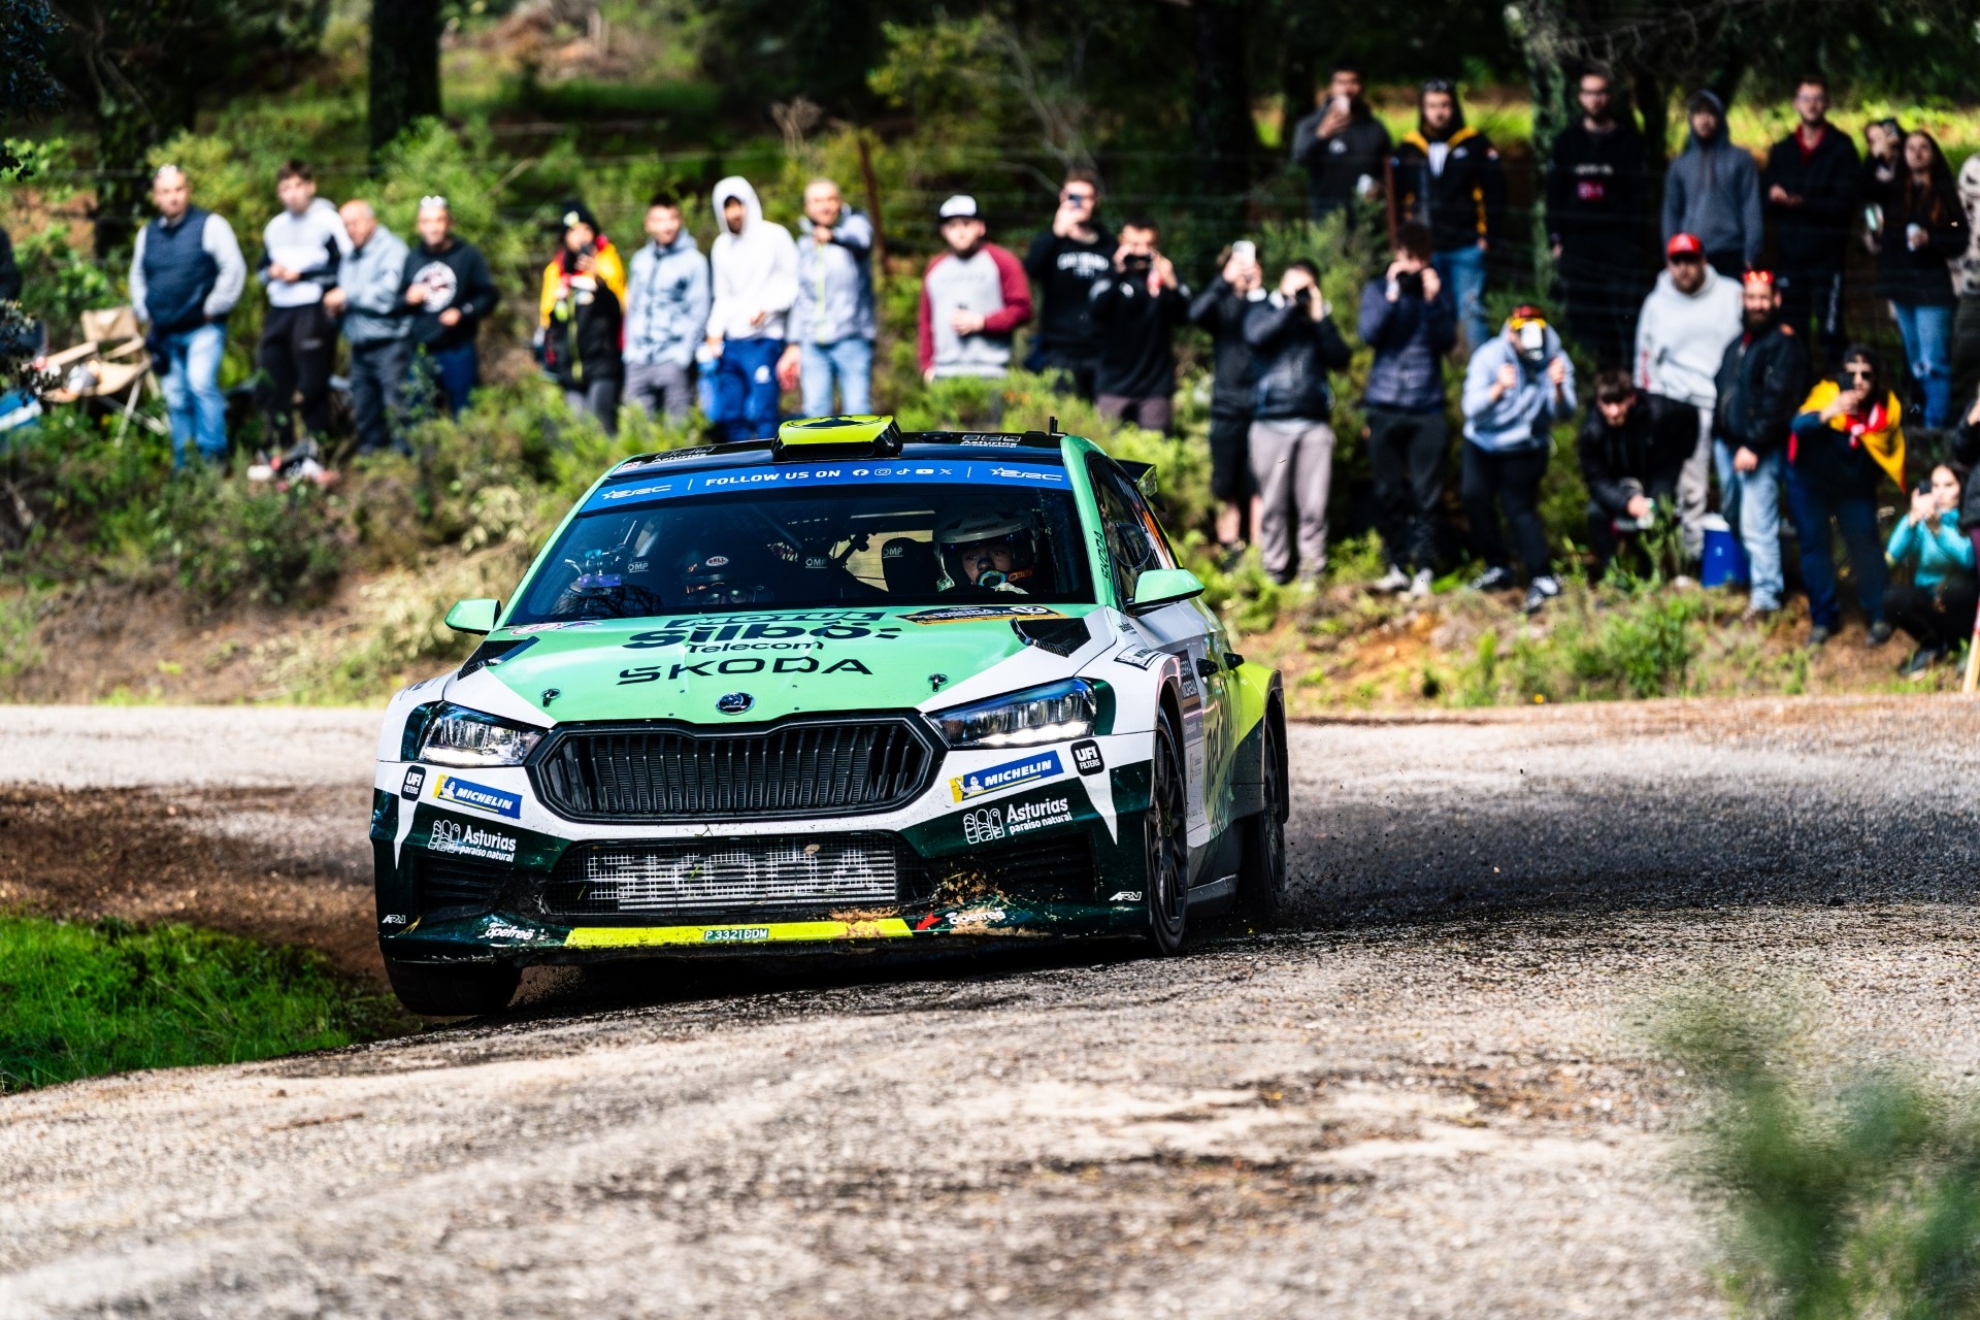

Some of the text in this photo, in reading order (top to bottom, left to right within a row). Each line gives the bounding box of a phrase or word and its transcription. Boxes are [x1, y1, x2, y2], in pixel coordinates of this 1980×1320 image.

[705, 472, 780, 486] FOLLOW
[785, 470, 809, 480] US
[815, 469, 841, 479] ON
[628, 562, 649, 573] OMP
[708, 556, 726, 565] BELL
[805, 557, 827, 567] OMP
[677, 612, 874, 626] MOTUL
[688, 640, 824, 654] Telecom
[616, 656, 874, 685] SKODA
[1075, 746, 1098, 762] UFI
[1079, 759, 1100, 770] FILTERS
[406, 772, 423, 786] UFI
[984, 759, 1052, 787] MICHELIN
[456, 787, 513, 810] MICHELIN
[1006, 798, 1069, 824] Asturias
[1009, 813, 1073, 835] paraíso natural
[463, 825, 517, 852] Asturias
[487, 850, 515, 862] natural
[705, 930, 713, 940] P
